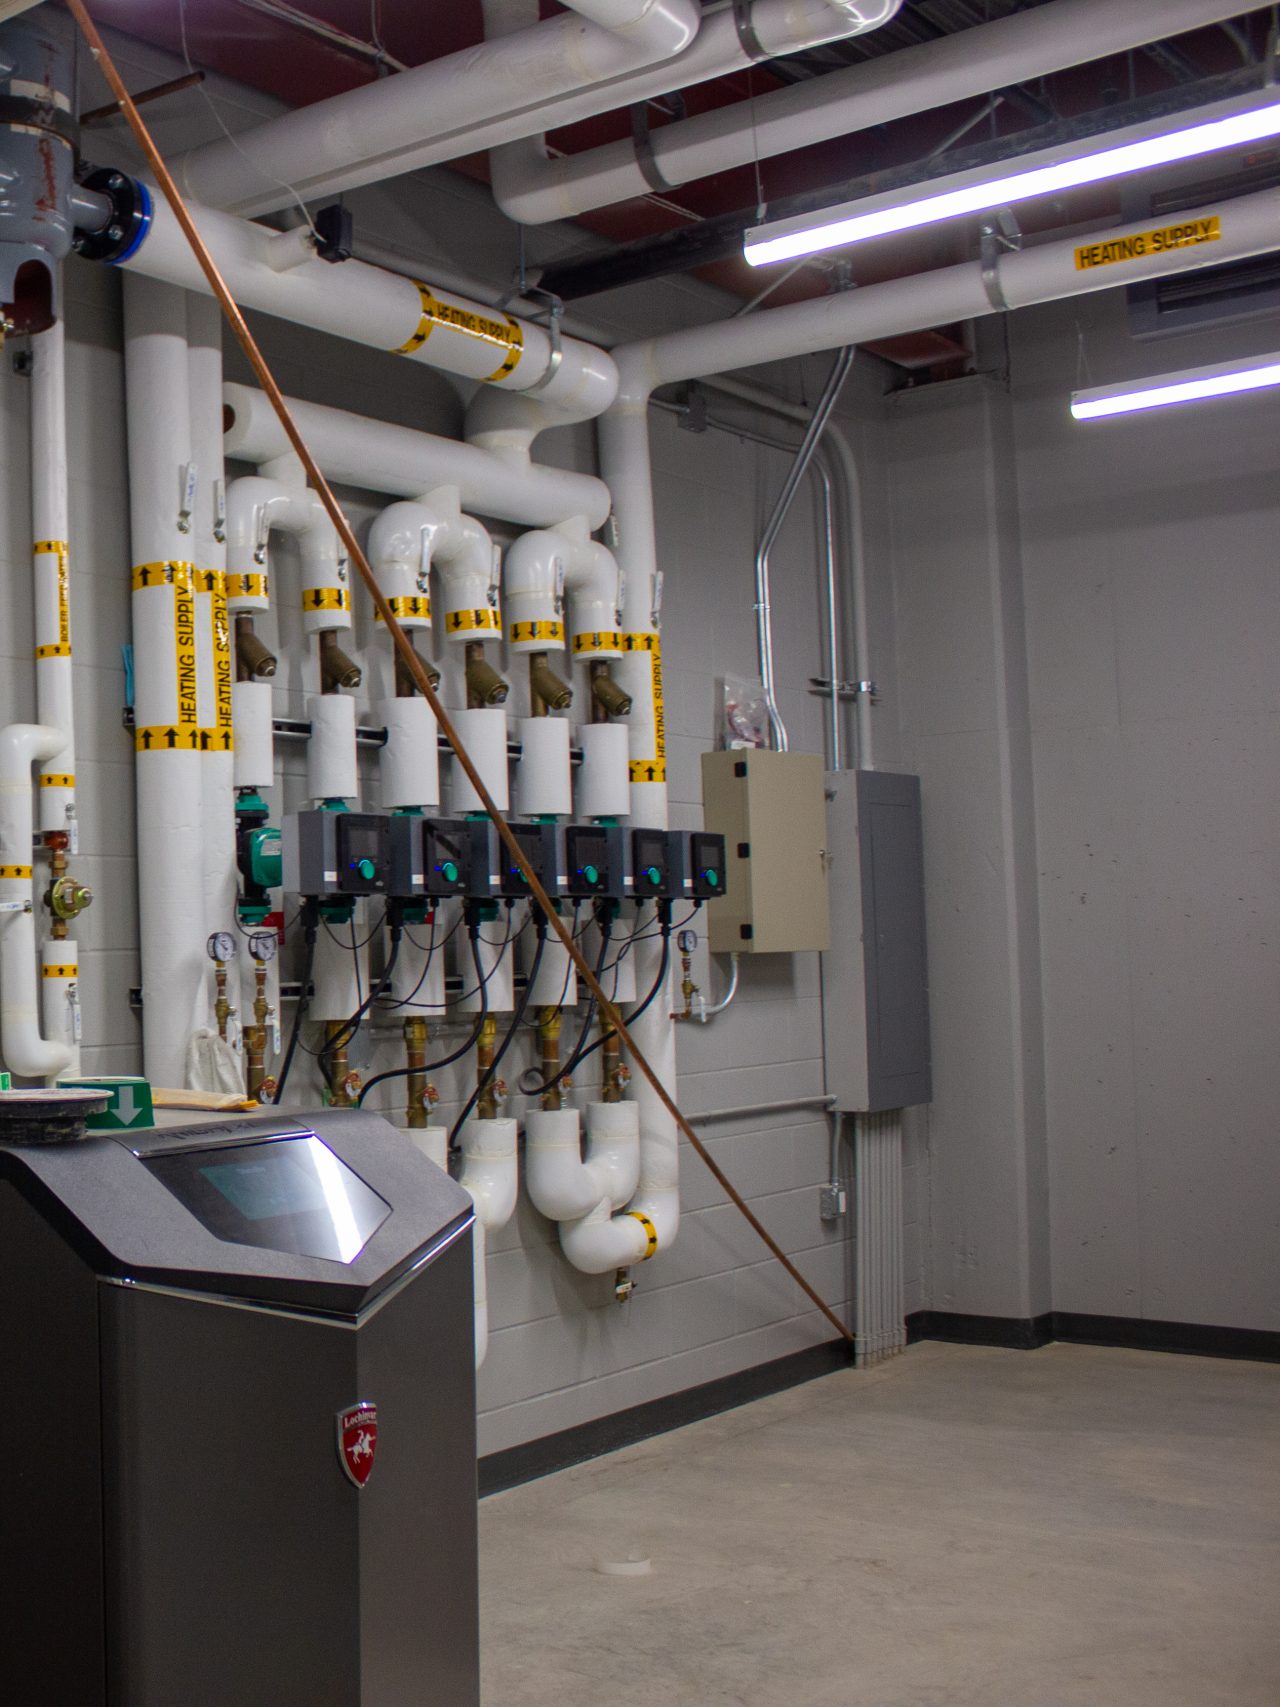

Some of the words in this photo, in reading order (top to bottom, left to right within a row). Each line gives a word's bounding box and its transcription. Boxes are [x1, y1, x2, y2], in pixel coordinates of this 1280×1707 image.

[1079, 236, 1145, 268] HEATING
[1151, 220, 1212, 251] SUPPLY
[437, 302, 475, 332] HEATING
[479, 318, 511, 342] SUPPLY
[176, 586, 195, 647] SUPPLY
[215, 593, 230, 653] SUPPLY
[178, 655, 197, 724] HEATING
[217, 660, 232, 727] HEATING
[653, 653, 662, 699] SUPPLY
[655, 706, 665, 758] HEATING
[344, 1410, 377, 1428] Lochinvar
